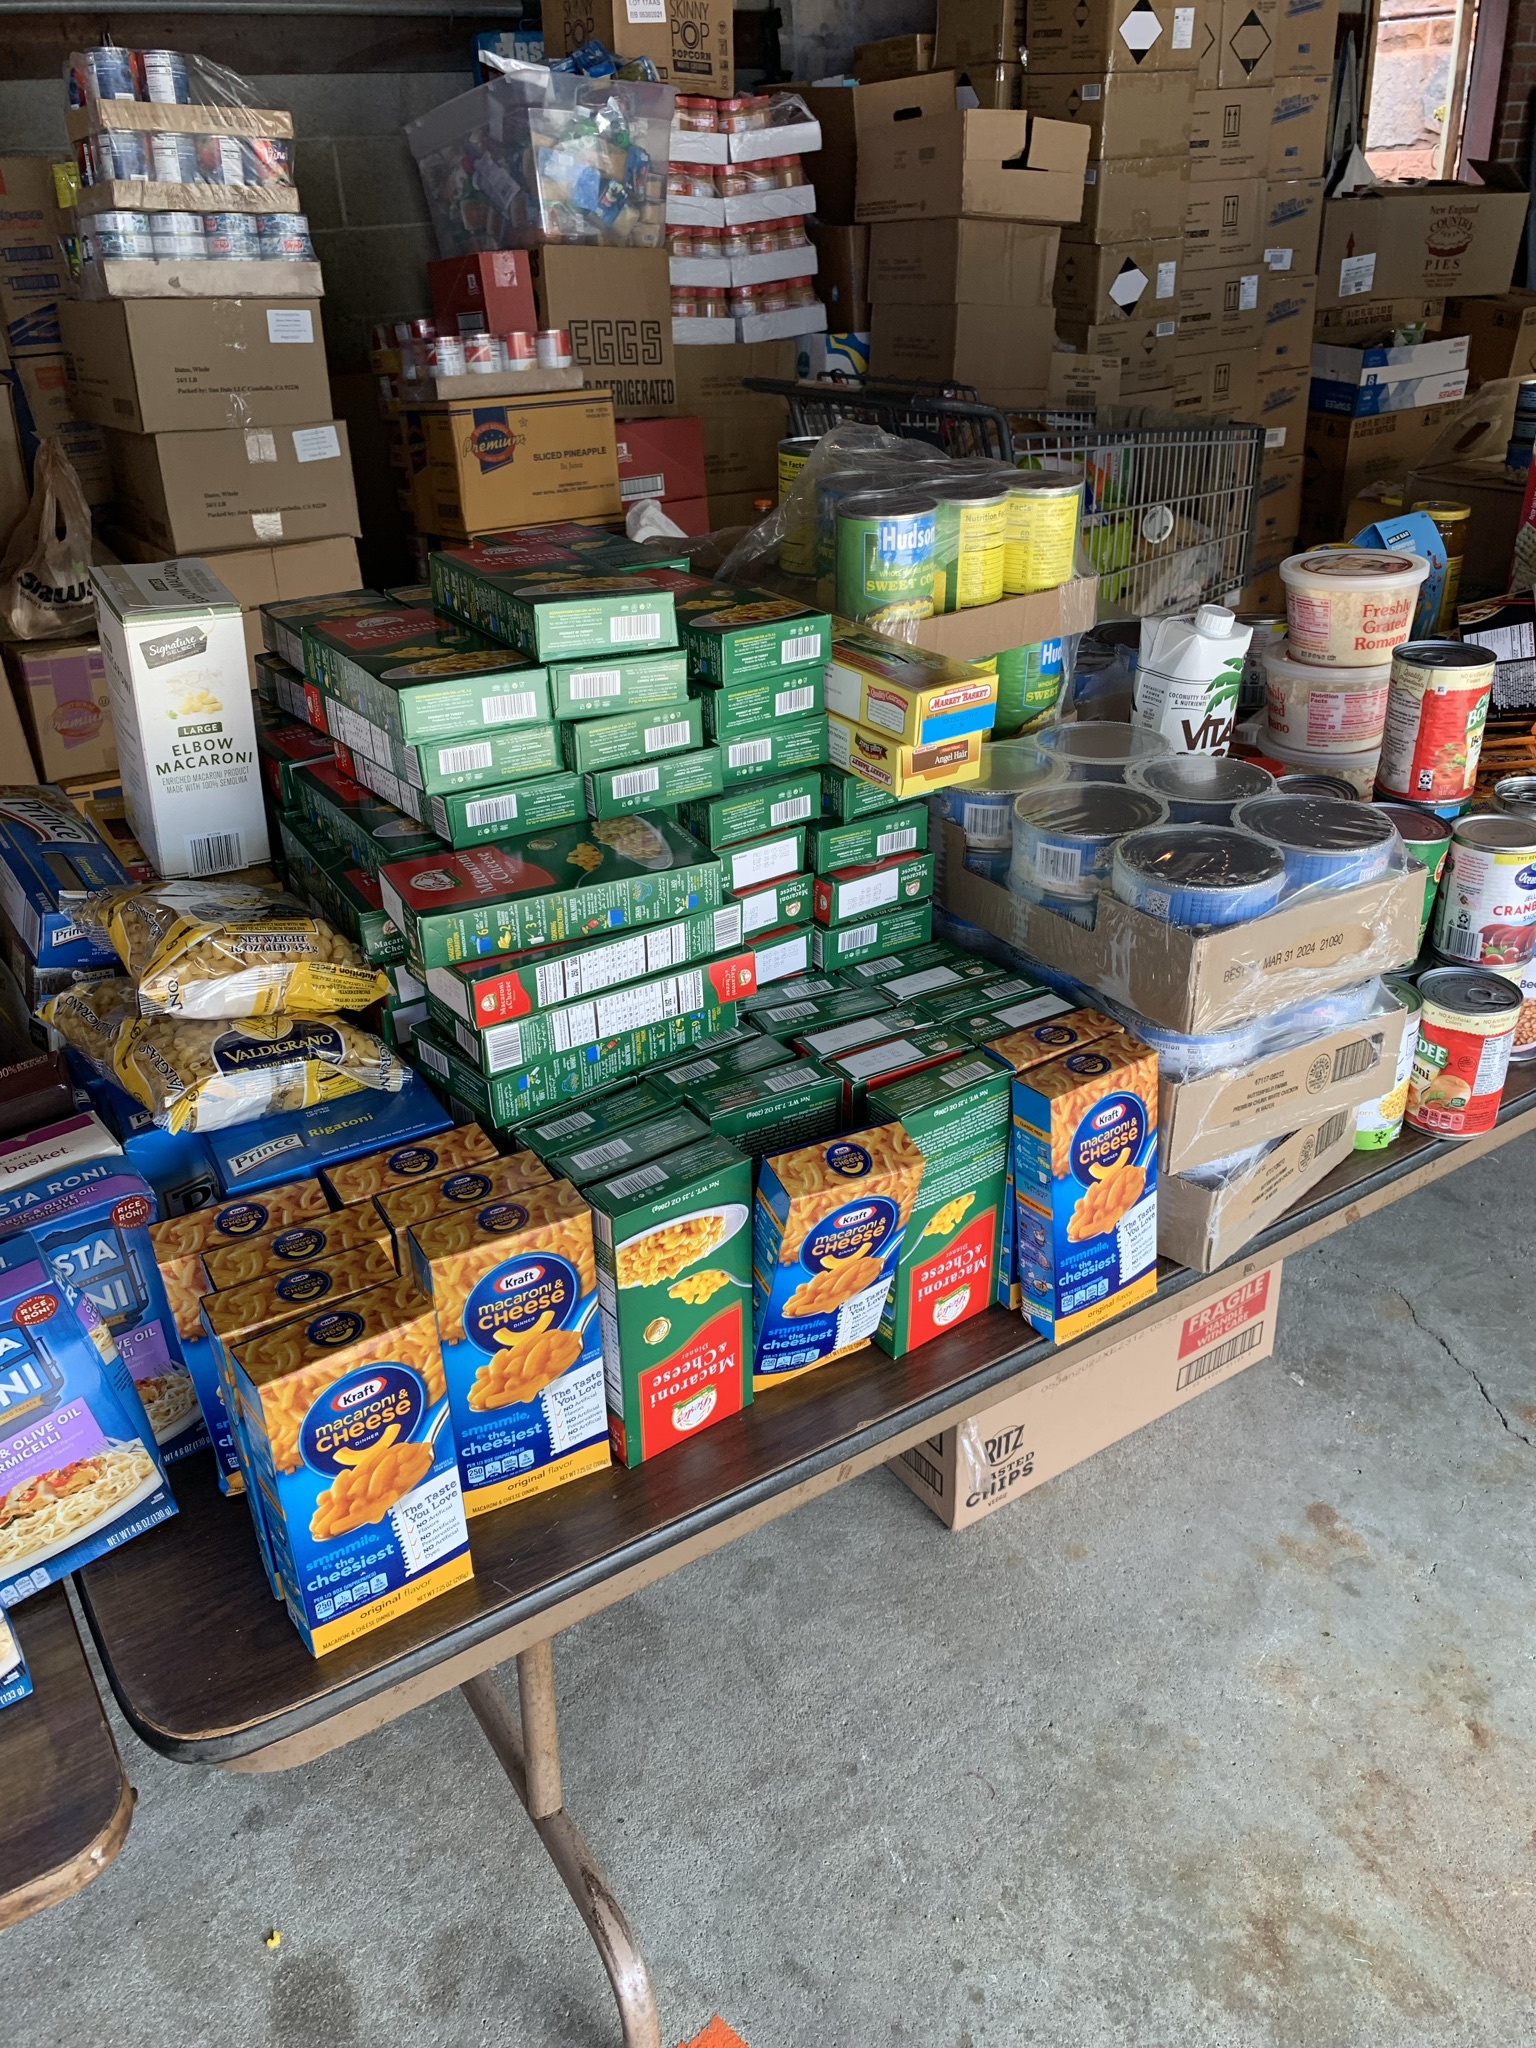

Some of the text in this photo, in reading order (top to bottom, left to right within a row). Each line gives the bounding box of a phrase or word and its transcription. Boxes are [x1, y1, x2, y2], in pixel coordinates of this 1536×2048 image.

[670, 1, 709, 19] SKINNY
[564, 18, 594, 47] POP
[671, 19, 710, 49] POP
[672, 49, 712, 61] POPCORN
[1430, 204, 1480, 215] New England
[1429, 216, 1476, 232] COUNTRY
[1425, 259, 1461, 271] PIES
[569, 320, 662, 365] EGGS
[463, 432, 526, 458] Premium
[533, 446, 607, 462] SLICED PINEAPPLE
[965, 511, 997, 523] Nutrition
[1009, 503, 1032, 512] Facts
[1388, 531, 1410, 545] MILK BAR
[866, 577, 918, 592] SWEET
[1363, 599, 1411, 618] Freshly
[1363, 614, 1407, 634] Grated
[149, 634, 197, 658] Signature
[165, 642, 197, 657] SELECT
[1354, 632, 1406, 651] Romano
[931, 689, 989, 710] MARKET BASKET
[1169, 692, 1199, 700] COCONUTTY
[1311, 692, 1339, 700] Nutrition
[183, 724, 218, 735] LARGE
[1181, 713, 1232, 751] VITA
[171, 737, 234, 757] ELBOW
[935, 749, 969, 765] Angel Hair
[155, 752, 253, 777] MACARONI
[162, 767, 249, 786] ENRICHED MACARONI PRODUCT
[166, 775, 248, 794] MADE WITH 100% SEMOLINA
[4, 801, 82, 839] Prince
[451, 853, 497, 895] Macaroni
[1493, 904, 1536, 917] CRANB
[240, 935, 307, 944] NET WEIGHT
[244, 944, 260, 954] OZ
[292, 943, 310, 953] 454
[1263, 933, 1344, 969] MAR 31 2024 21090
[338, 966, 377, 982] Nutrition
[1448, 1013, 1472, 1024] Artificial
[222, 1033, 333, 1065] VALDIGRANO
[308, 1112, 375, 1138] Rigatoni
[1099, 1110, 1119, 1125] Kraft
[1079, 1127, 1139, 1165] CHeese
[1080, 1121, 1130, 1151] macaroni
[4, 1146, 68, 1175] basket
[233, 1138, 296, 1170] Prince
[47, 1166, 108, 1195] RONI
[44, 1186, 98, 1210] OLIVE OIL
[117, 1200, 141, 1215] RICE
[651, 1179, 720, 1213] Net 7.25 OZ (206g)
[842, 1211, 868, 1225] Kraft
[1136, 1203, 1156, 1222] Taste
[811, 1225, 885, 1257] CHeese
[815, 1220, 878, 1246] macaroni
[505, 1271, 534, 1289] Kraft
[918, 1254, 988, 1302] Macaroni
[1058, 1253, 1117, 1288] cheesiest
[20, 1299, 47, 1316] RICE
[478, 1278, 564, 1316] macaroni &
[1189, 1275, 1265, 1333] FRAGILE
[478, 1289, 565, 1331] CHeese
[1087, 1299, 1115, 1319] original
[768, 1319, 828, 1337] smmmile,
[1196, 1313, 1250, 1348] WITH CARE
[1204, 1306, 1245, 1336] HANDLE
[762, 1328, 834, 1351] cheesiest
[788, 1333, 804, 1341] the
[682, 1343, 710, 1361] Dinner
[552, 1370, 603, 1402] The Taste
[650, 1352, 737, 1408] Macaroni
[343, 1384, 375, 1406] Kraft
[557, 1379, 603, 1407] You Love
[315, 1388, 409, 1440] macaroni &
[461, 1411, 530, 1438] smmmile,
[12, 1408, 82, 1450] OLIVE OIL
[316, 1399, 412, 1453] CHeese
[487, 1430, 507, 1441] the
[354, 1431, 380, 1447] DINNER
[461, 1423, 542, 1457] cheesiest
[985, 1424, 1025, 1465] RITZ
[507, 1459, 574, 1491] original flavor
[966, 1461, 1034, 1508] CHIPS
[402, 1479, 458, 1518] The Taste
[408, 1490, 459, 1525] You Love
[416, 1504, 453, 1530] NO Artificial
[418, 1519, 440, 1535] Flavors
[106, 1532, 121, 1547] NET
[421, 1521, 461, 1548] Preservatives
[305, 1533, 380, 1572] smmmile,
[334, 1556, 355, 1571] the
[424, 1548, 441, 1560] Dyes
[306, 1543, 395, 1592] cheesiest
[317, 1600, 333, 1612] 250
[359, 1578, 433, 1620] original flavor
[322, 1632, 351, 1651] MACARONI
